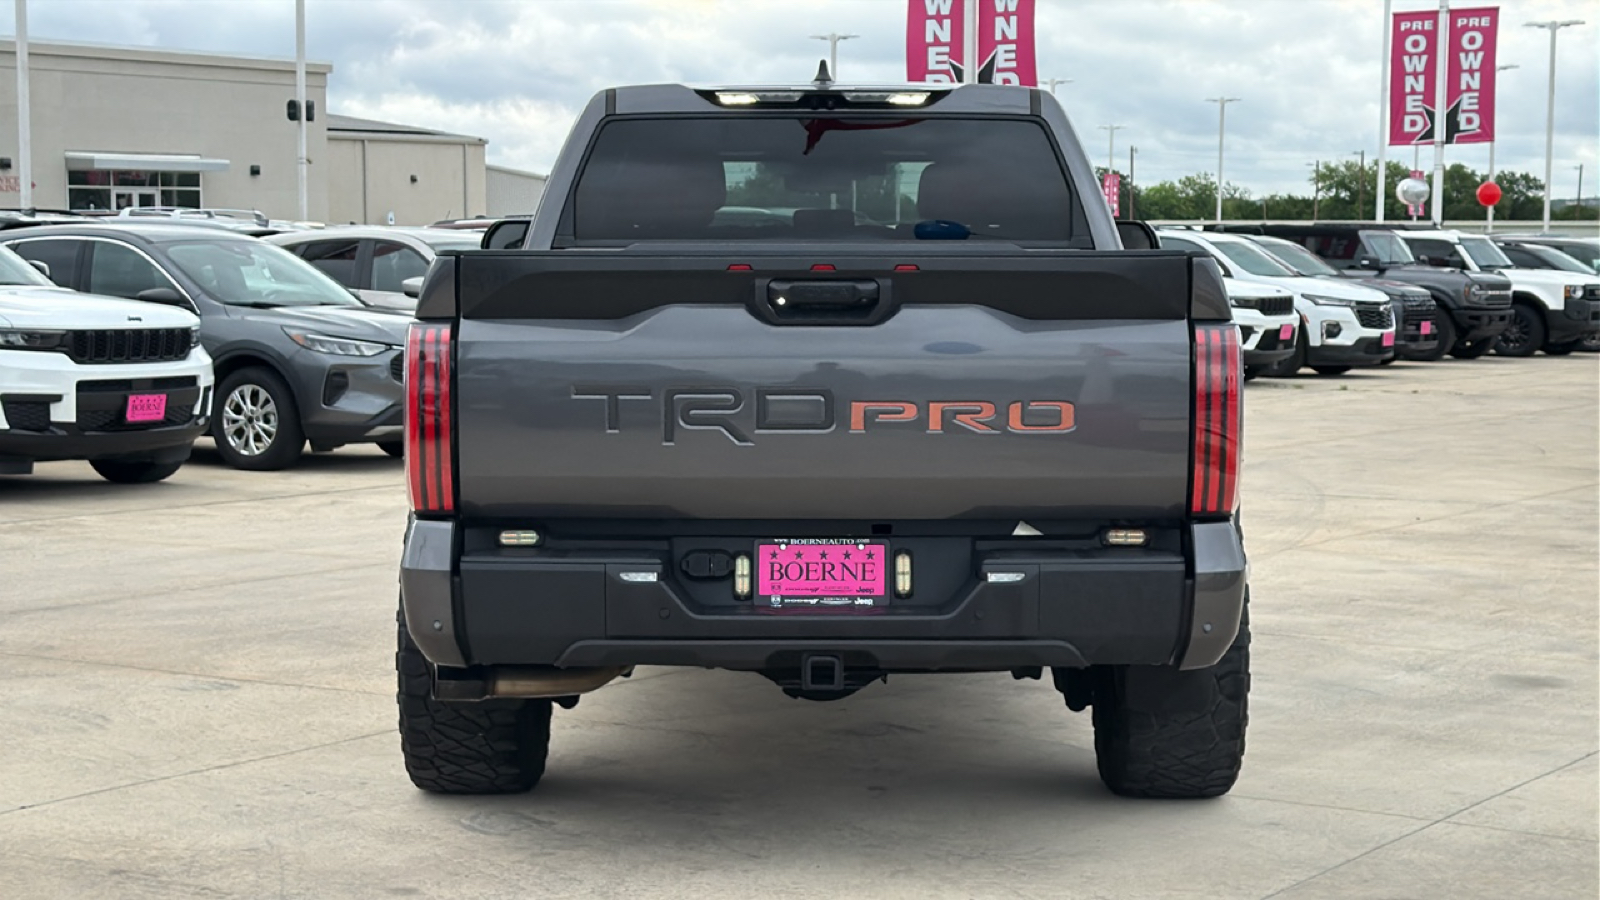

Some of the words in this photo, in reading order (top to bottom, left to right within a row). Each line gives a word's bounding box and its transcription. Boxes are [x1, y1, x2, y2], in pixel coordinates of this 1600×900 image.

[1400, 20, 1434, 31] PRE
[1457, 16, 1491, 28] PRE
[1403, 34, 1428, 133] OWNED
[1459, 31, 1484, 131] OWNED
[570, 386, 836, 446] TRD
[848, 400, 1077, 434] PRO
[769, 561, 876, 581] BOERNE
[856, 586, 875, 595] Jeep
